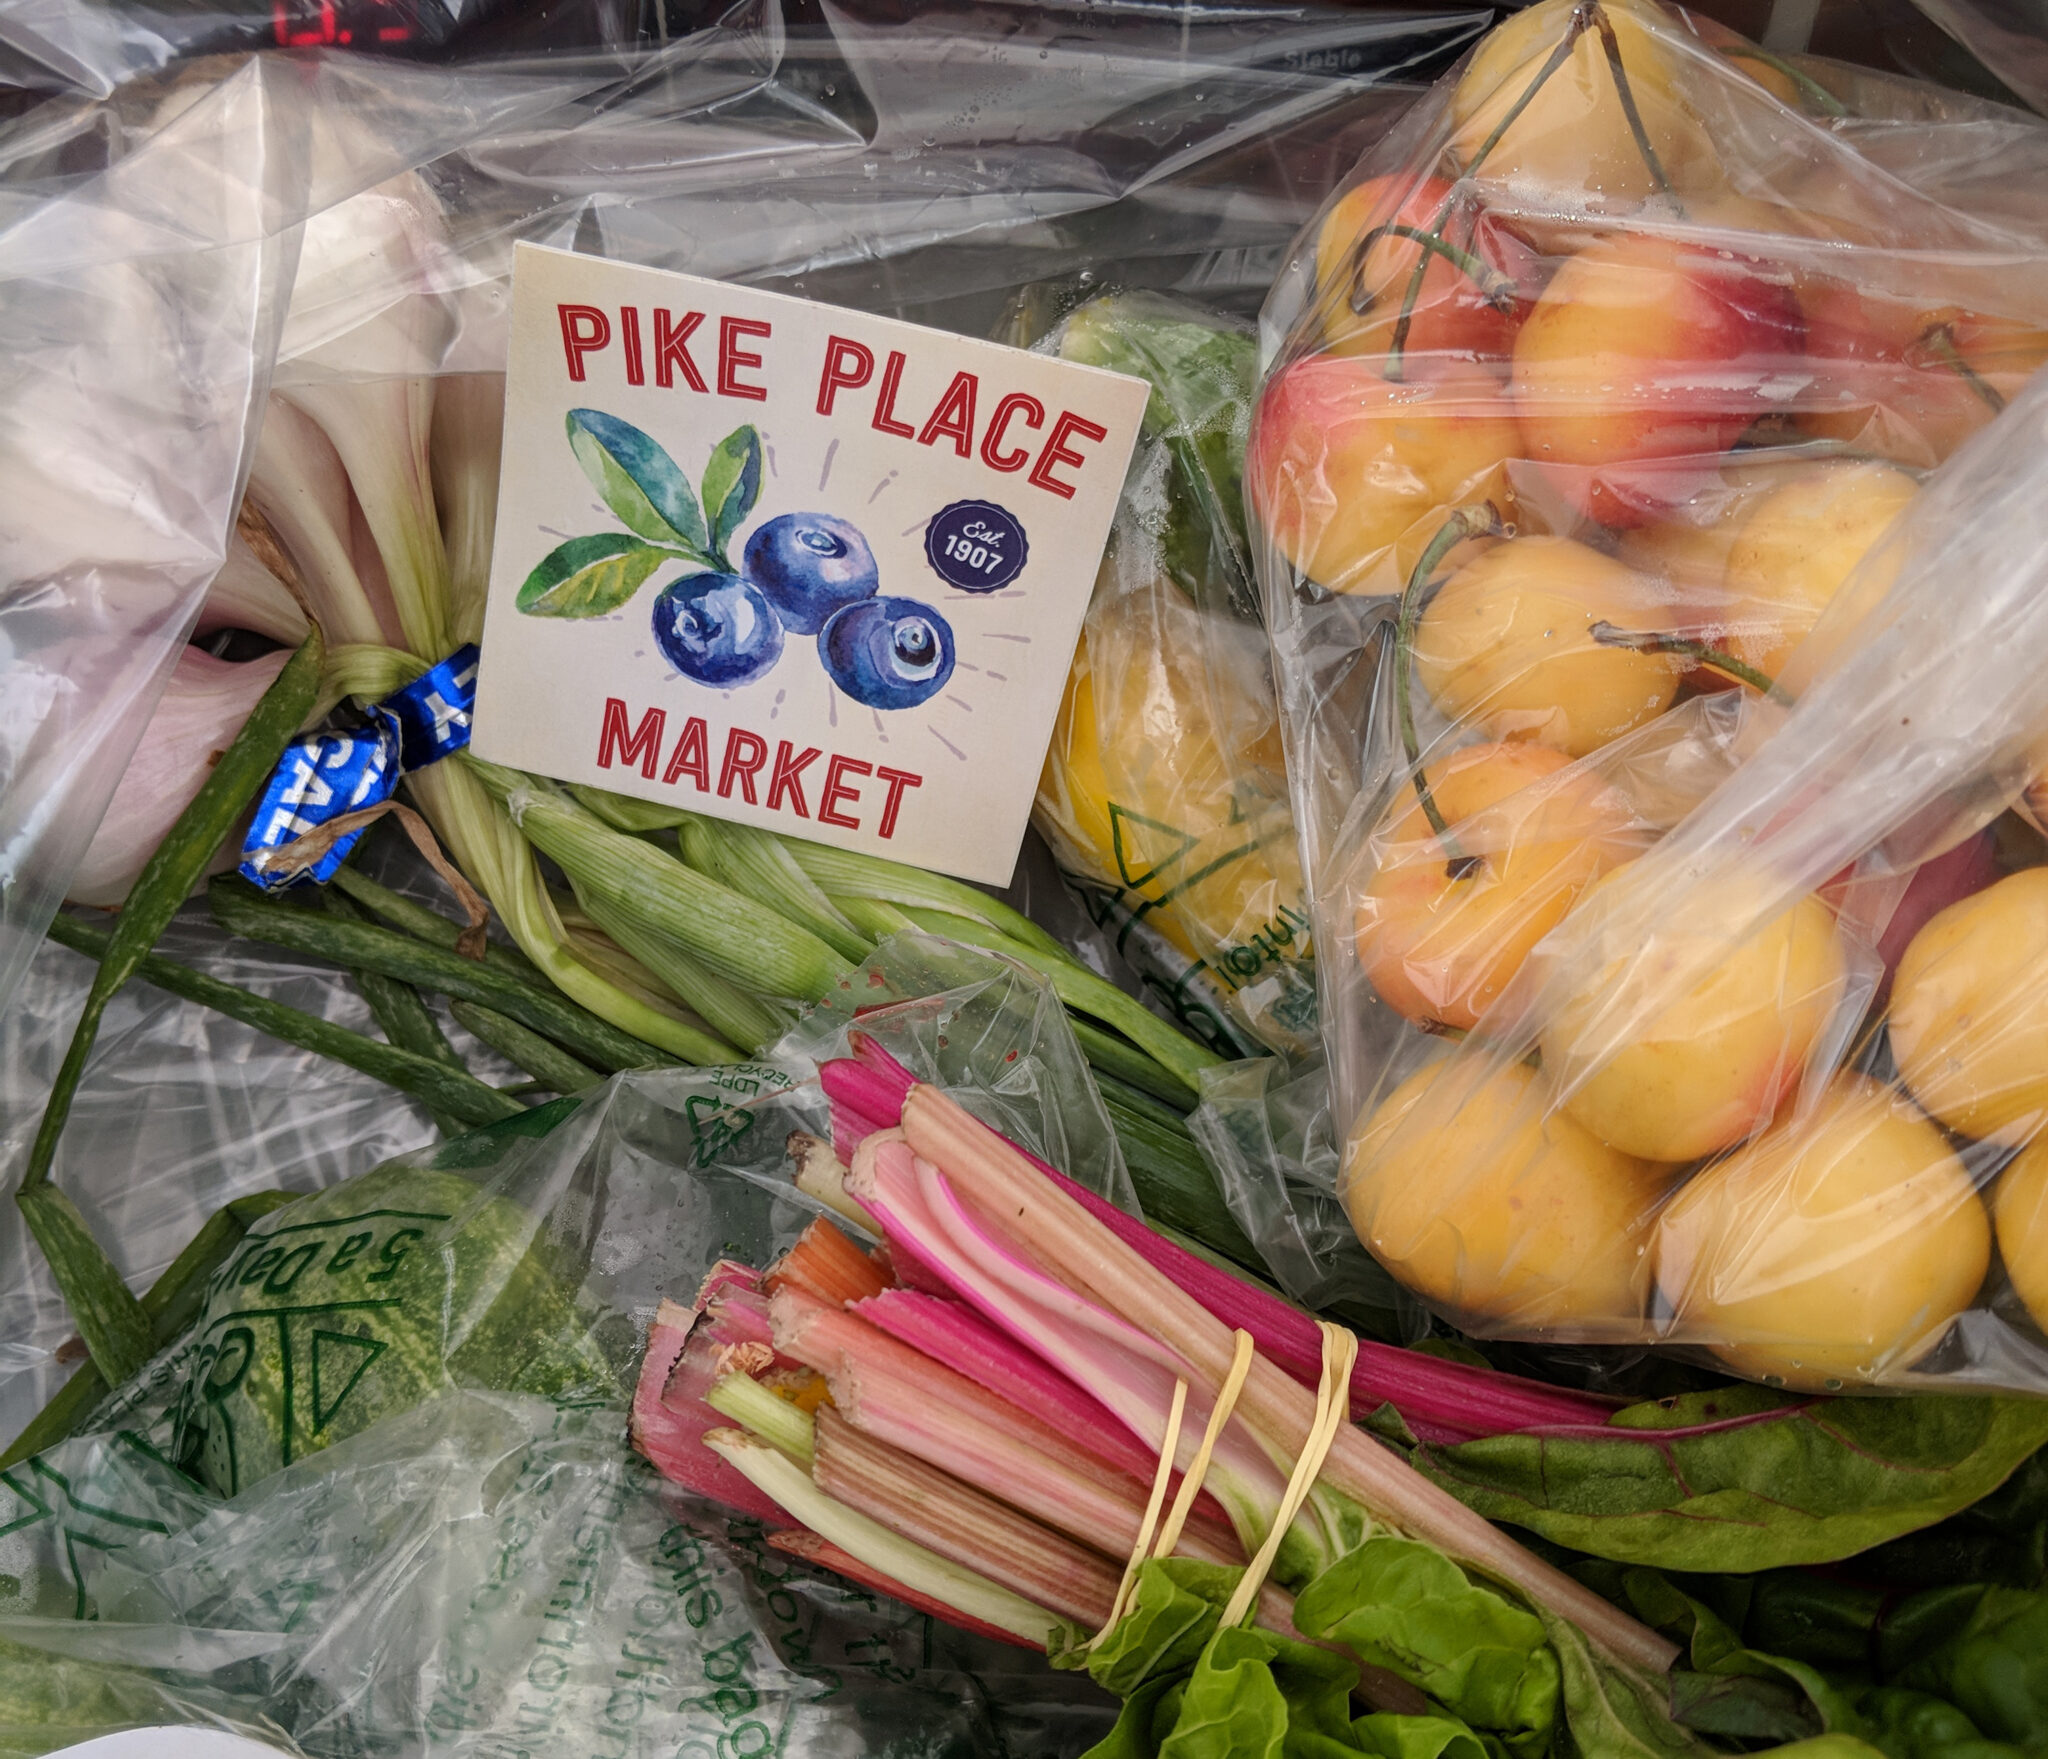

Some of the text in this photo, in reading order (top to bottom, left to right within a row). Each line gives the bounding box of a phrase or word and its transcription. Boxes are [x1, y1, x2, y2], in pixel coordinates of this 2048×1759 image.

[558, 304, 1107, 499] PIKE PLACE
[944, 534, 1004, 574] 1907
[962, 521, 1006, 548] Est.
[598, 698, 922, 838] MARKET
[709, 1069, 760, 1097] LDPE
[324, 1231, 373, 1276] a
[366, 1228, 425, 1284] 5
[702, 1631, 776, 1759] bag
